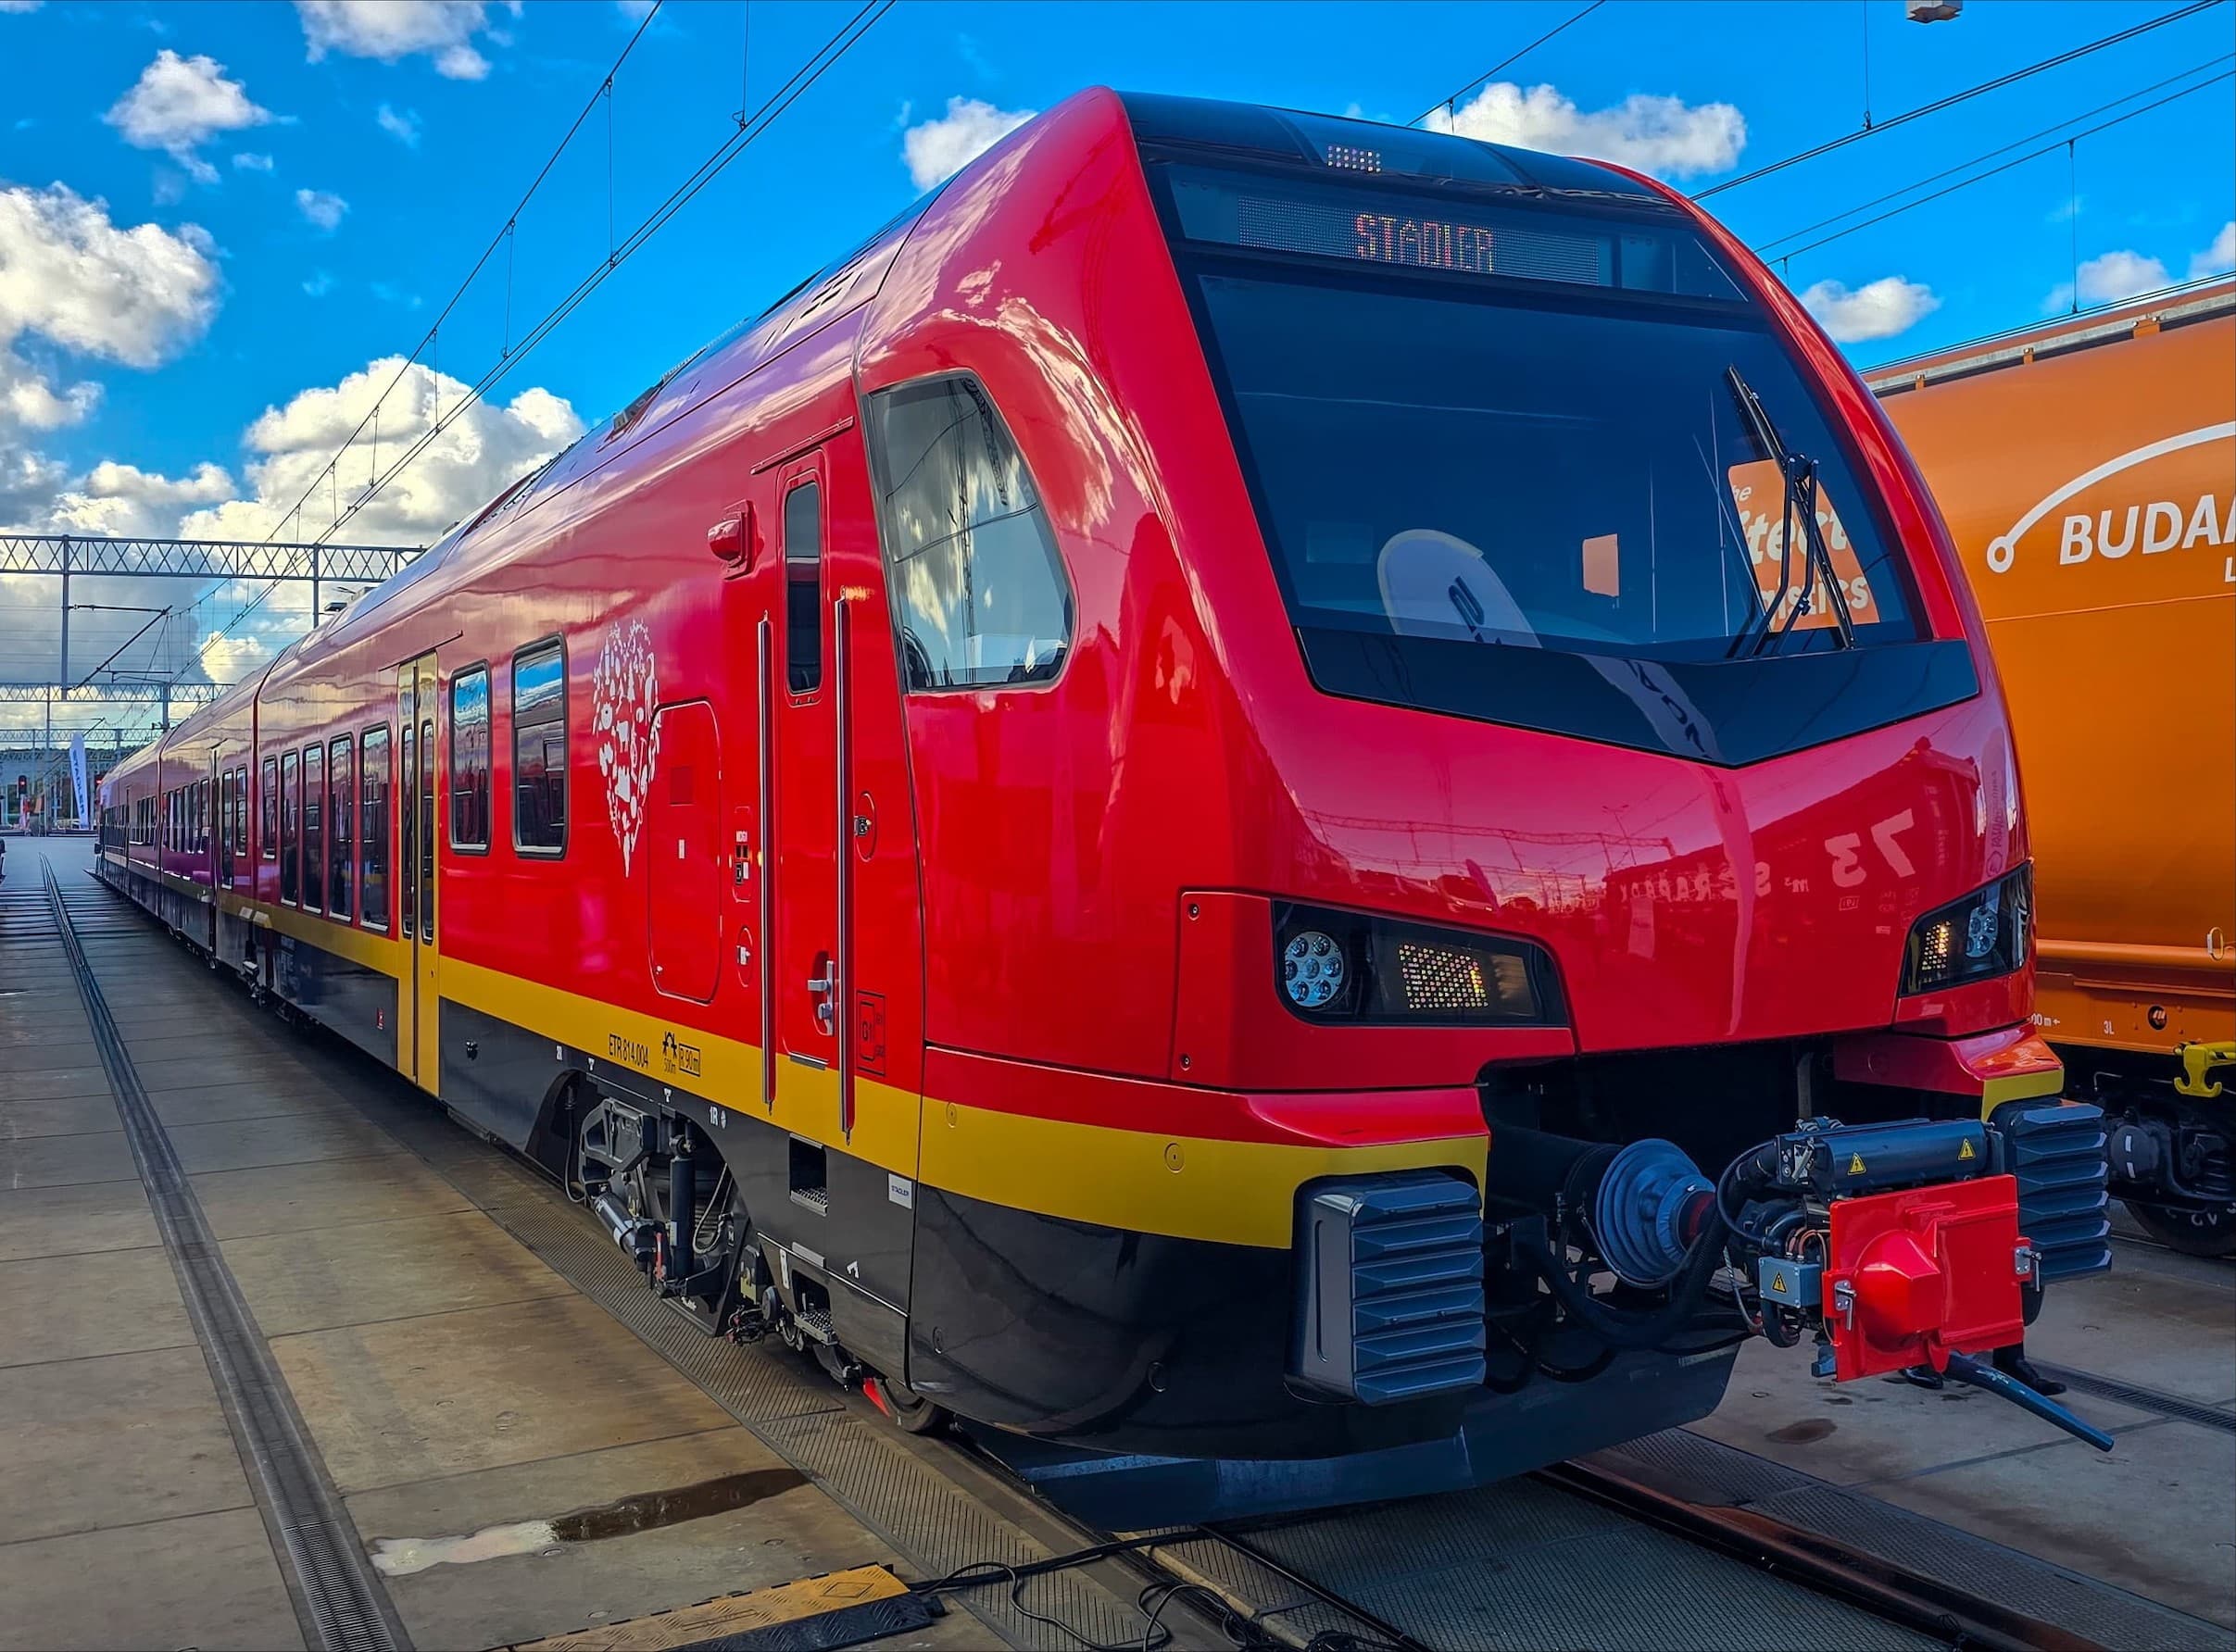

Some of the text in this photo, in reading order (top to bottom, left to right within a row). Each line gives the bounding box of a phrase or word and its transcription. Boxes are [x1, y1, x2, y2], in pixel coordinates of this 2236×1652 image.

[1356, 213, 1494, 274] STADLER
[2059, 493, 2236, 566] BUDA
[2104, 1020, 2115, 1035] 3L
